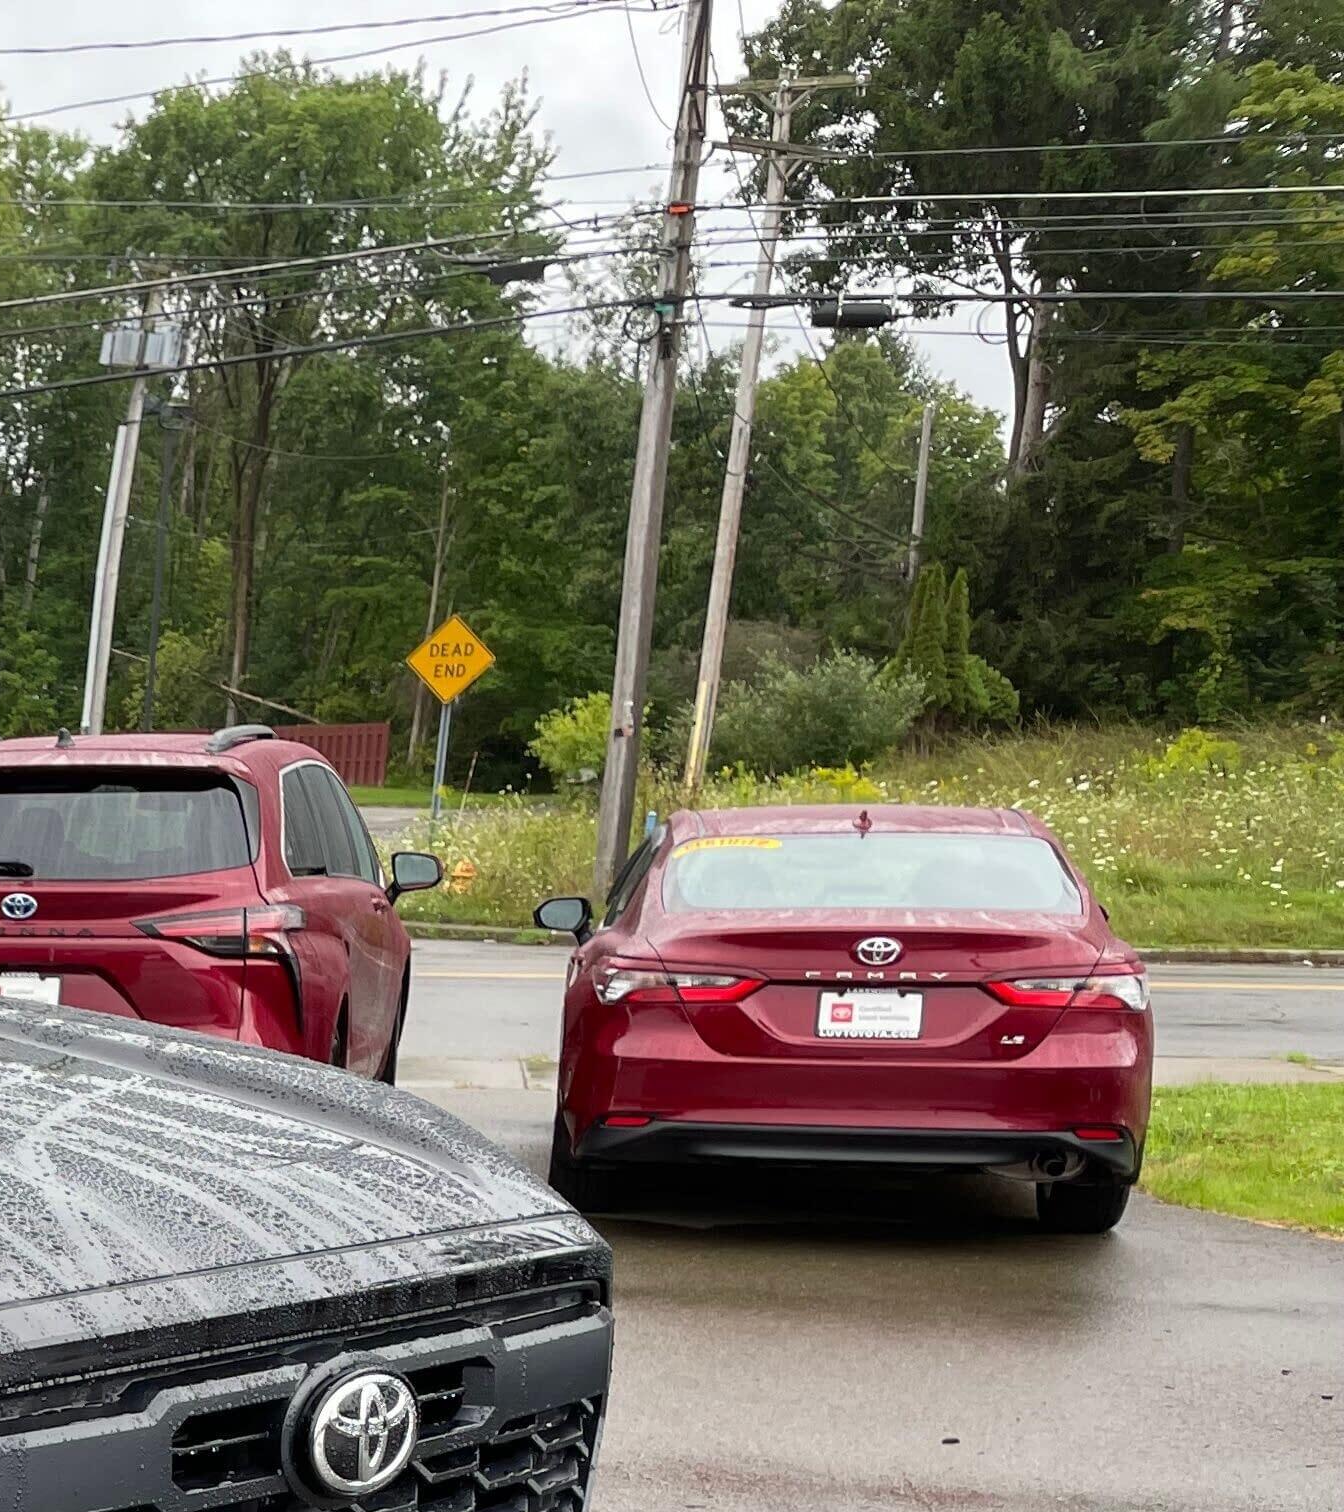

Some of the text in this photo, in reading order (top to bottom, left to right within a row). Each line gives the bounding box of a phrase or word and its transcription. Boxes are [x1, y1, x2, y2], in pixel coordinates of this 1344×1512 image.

[429, 642, 475, 658] DEAD
[433, 663, 467, 679] END
[805, 970, 950, 980] CAMRY
